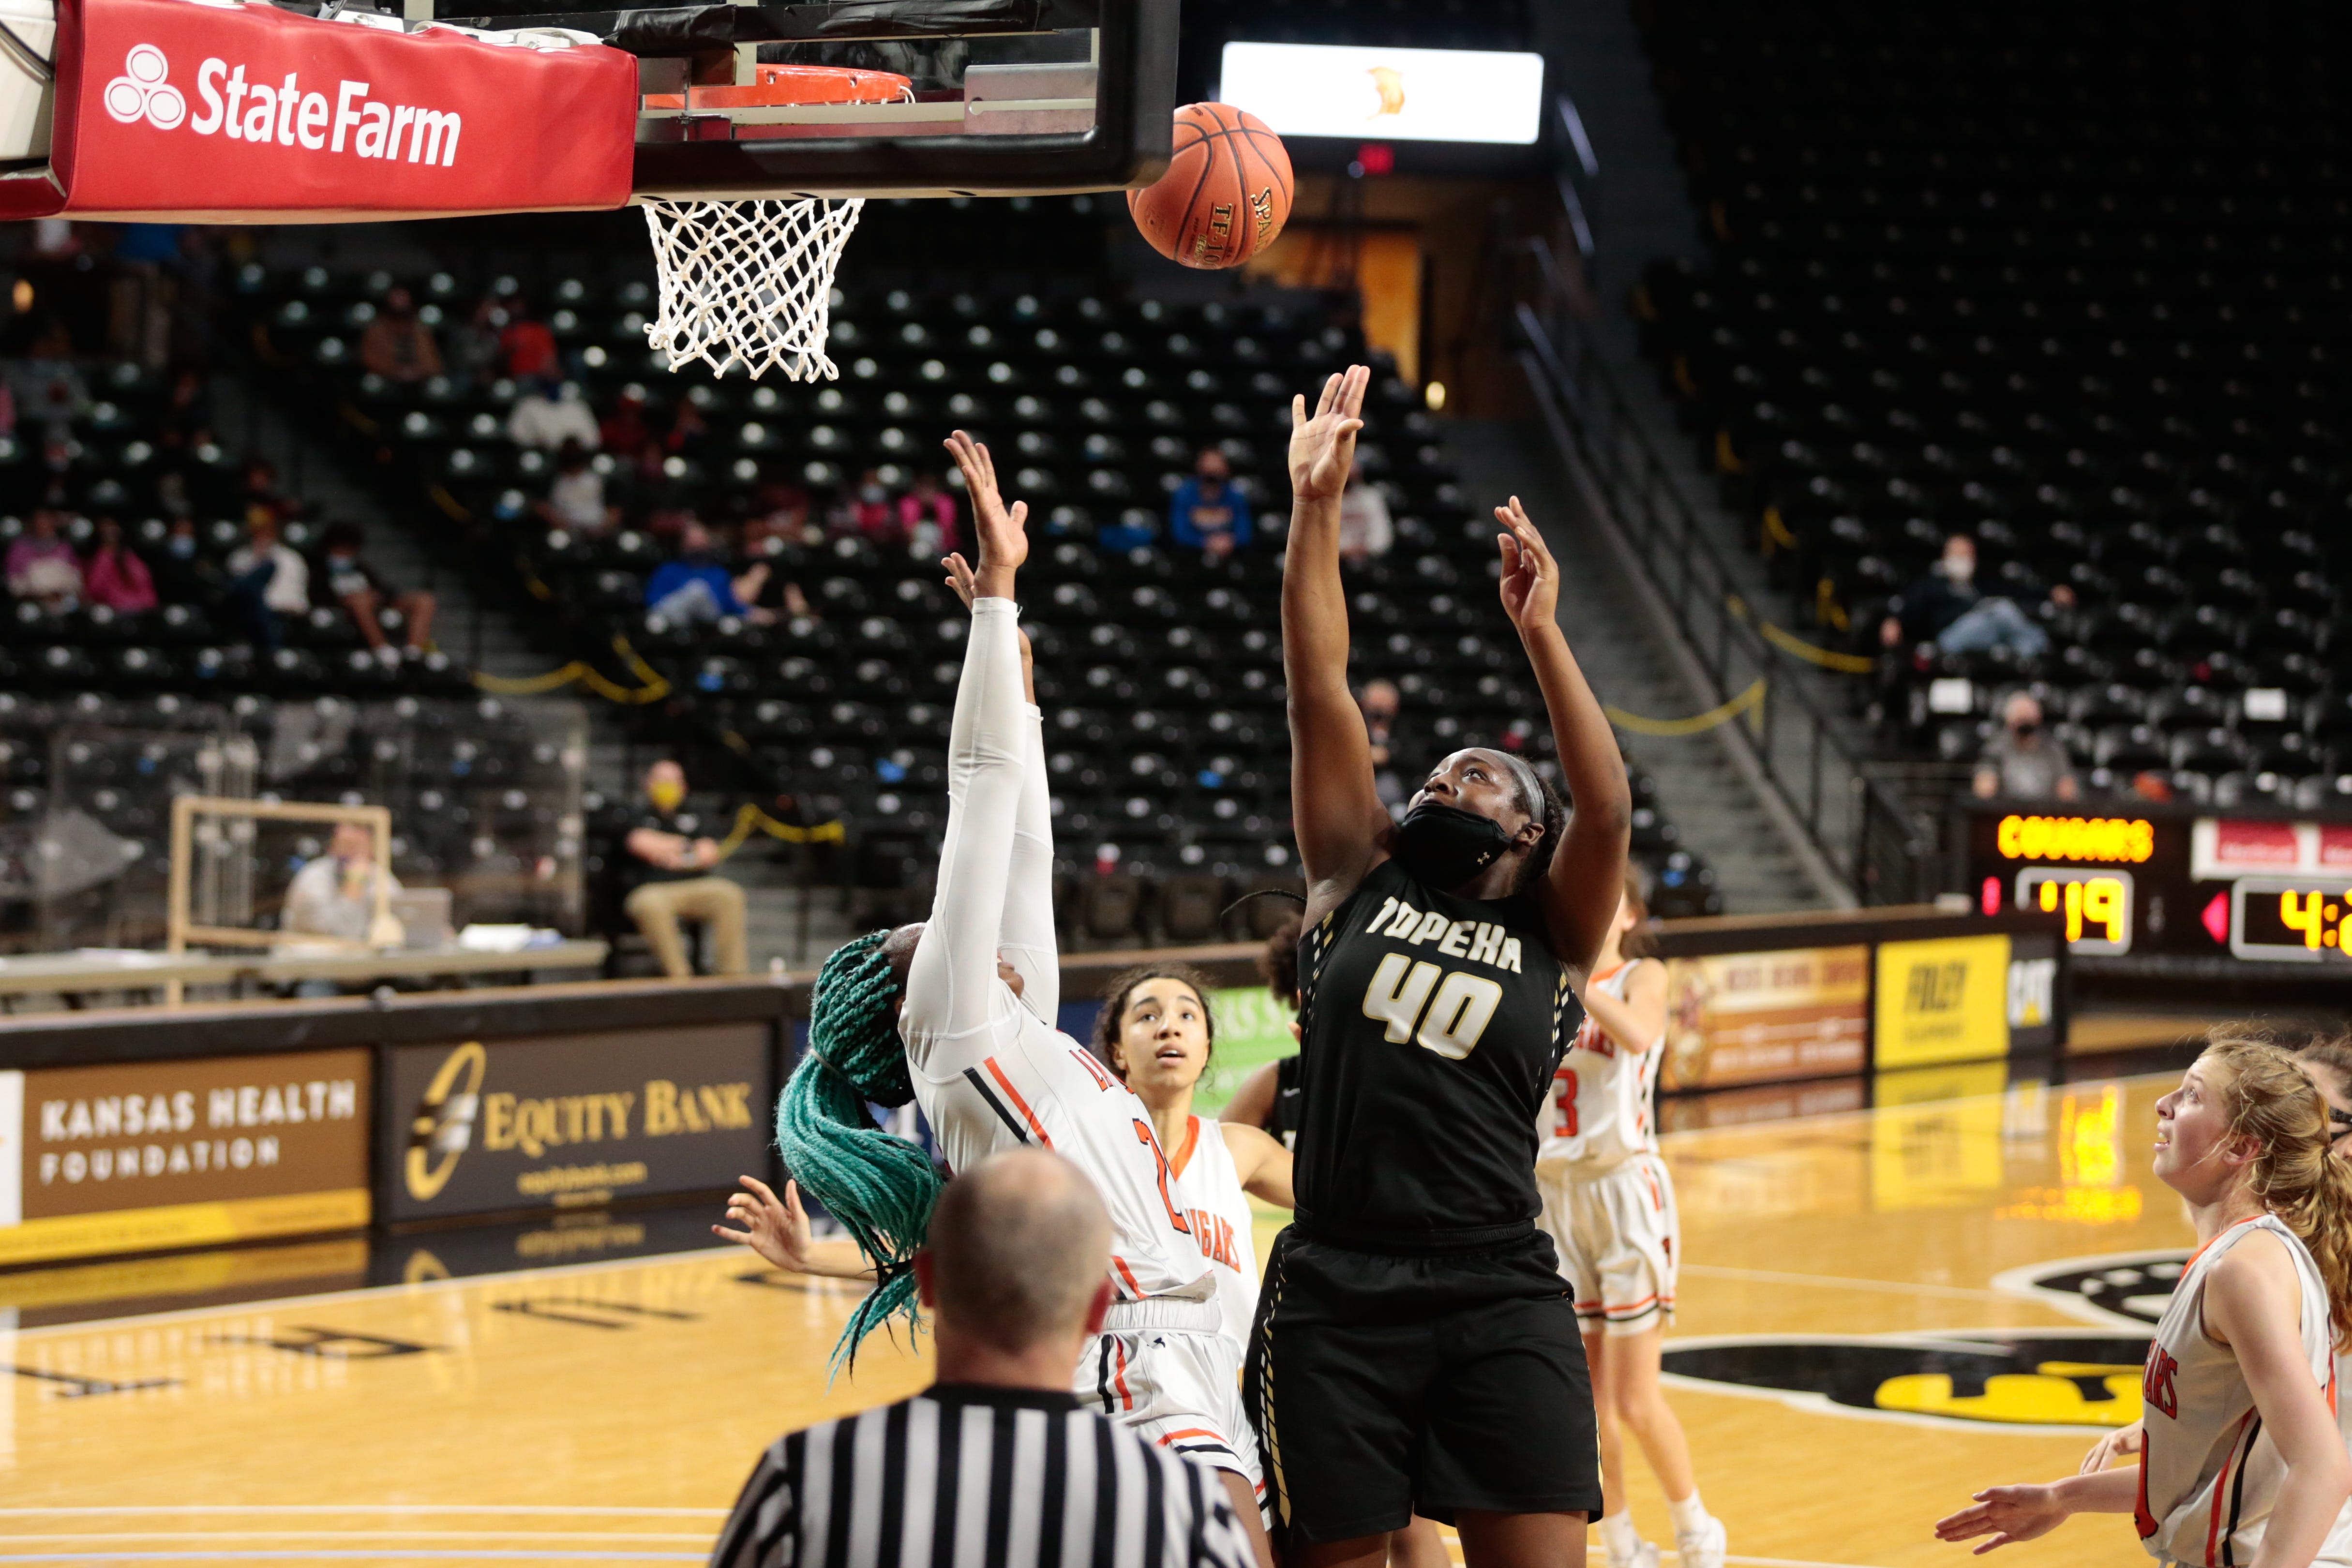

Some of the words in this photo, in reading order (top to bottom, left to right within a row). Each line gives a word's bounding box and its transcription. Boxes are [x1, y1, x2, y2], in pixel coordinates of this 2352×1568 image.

[1365, 896, 1522, 973] TOPEKA
[2280, 889, 2352, 957] 4:
[1362, 953, 1502, 1060] 40
[40, 1090, 195, 1141] KANSAS
[208, 1080, 355, 1128] HEALTH
[40, 1136, 279, 1185] FOUNDATION
